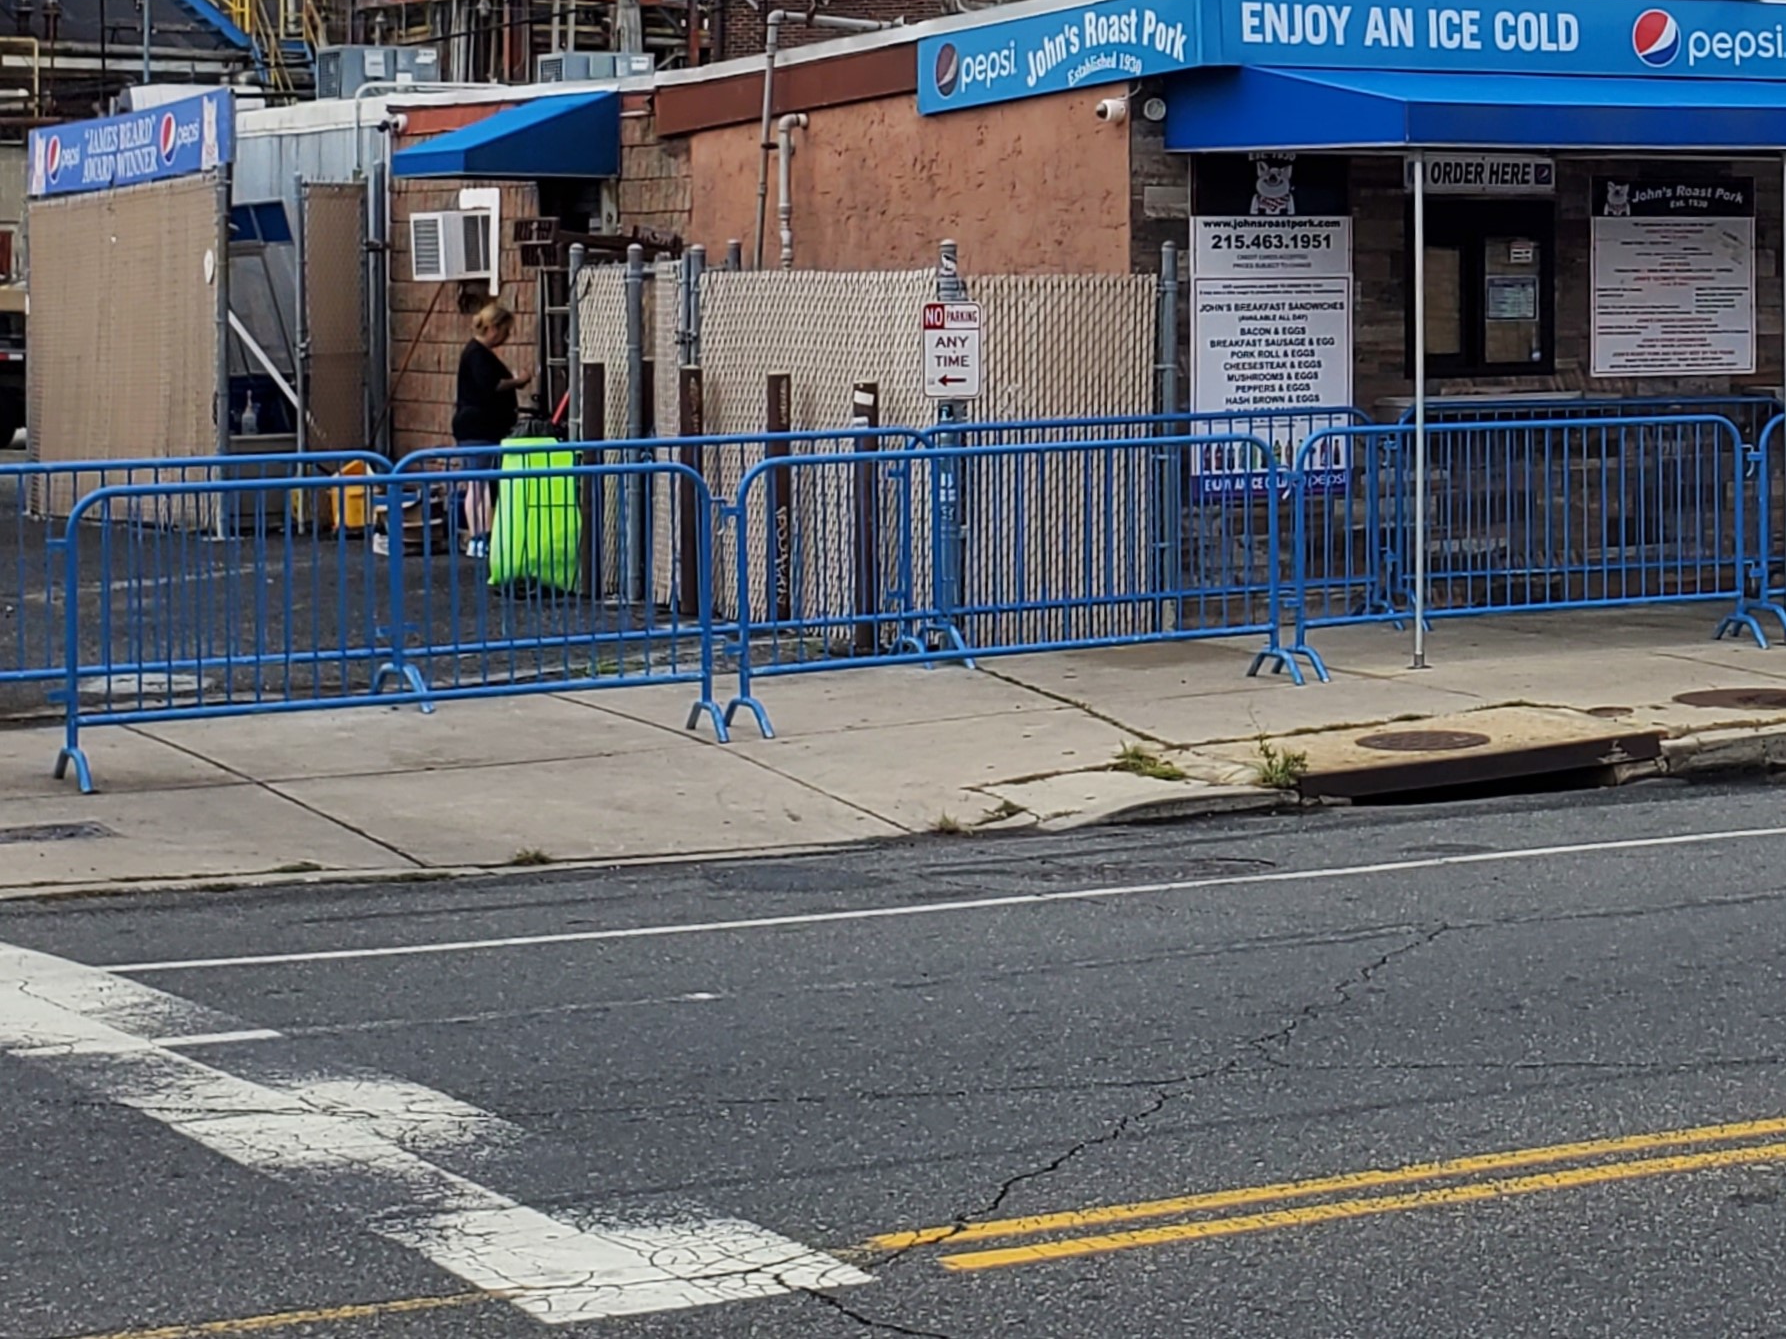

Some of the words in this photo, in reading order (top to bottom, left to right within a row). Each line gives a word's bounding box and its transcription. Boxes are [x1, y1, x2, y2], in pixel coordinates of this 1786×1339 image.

[1241, 1, 1351, 45] ENJOY
[1364, 6, 1414, 48] AN
[1428, 9, 1481, 50] ICE
[1494, 11, 1579, 52] COLD
[1026, 24, 1080, 87] John's
[1084, 8, 1138, 49] Roast
[1142, 9, 1188, 62] Pork
[1689, 24, 1784, 66] pepsi
[961, 40, 1016, 92] pepsi
[1067, 51, 1117, 86] Established
[1119, 52, 1142, 75] 1930
[176, 118, 200, 150] pepsi
[82, 154, 115, 184] AWARD
[117, 147, 158, 177] WINNER
[1430, 162, 1486, 185] ORDER
[1488, 163, 1531, 185] HERE
[1632, 186, 1672, 203] John's
[1676, 185, 1712, 198] Roast
[1715, 187, 1743, 204] Pork
[1203, 219, 1341, 230] www.johnsroastpork.com
[1211, 234, 1332, 249] 215.463.1951
[1200, 303, 1231, 312] JOHN'S
[1234, 302, 1286, 312] BREAKFAST
[1288, 301, 1344, 311] SANDWICHES
[926, 307, 943, 326] NO
[947, 311, 977, 323] PARKING
[1240, 327, 1271, 336] BACON
[1282, 326, 1306, 335] EGGS
[935, 336, 969, 348] ANY
[1210, 338, 1262, 348] BREAKFAST
[1265, 338, 1305, 347] SAUSAGE
[1316, 336, 1335, 346] EGG
[1231, 350, 1256, 359] PORK
[1258, 350, 1280, 359] ROLL
[1291, 349, 1315, 358] EGGS
[935, 355, 970, 367] TIME
[1223, 361, 1287, 371] CHEESESTEAK
[1298, 360, 1322, 369] EGGS
[1227, 372, 1284, 382] MUSHROOMS
[1294, 371, 1319, 380] EGGS
[1235, 384, 1275, 393] PEPPERS
[1286, 383, 1311, 392] EGGS
[1225, 396, 1250, 405] HASH
[1252, 395, 1285, 404] BROWN
[1296, 394, 1320, 403] EGGS
